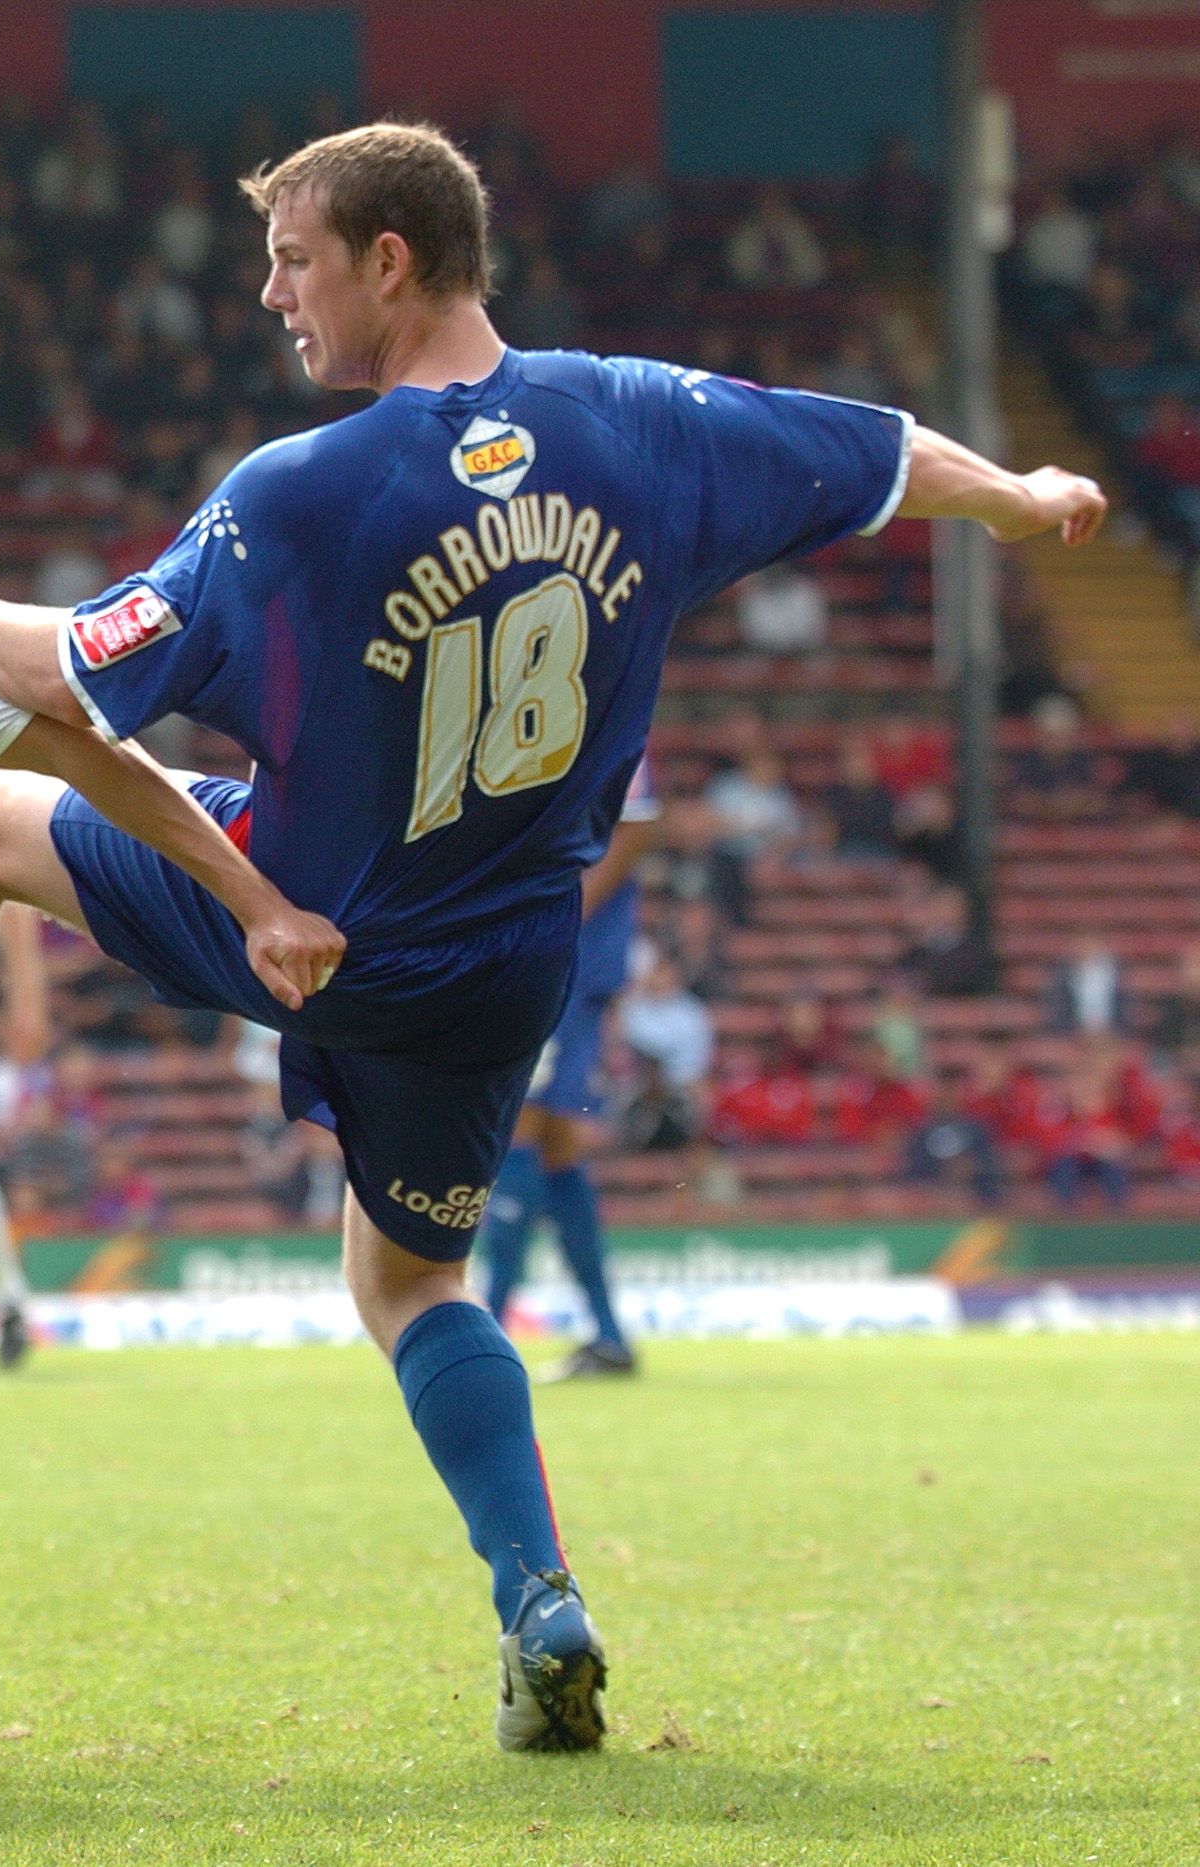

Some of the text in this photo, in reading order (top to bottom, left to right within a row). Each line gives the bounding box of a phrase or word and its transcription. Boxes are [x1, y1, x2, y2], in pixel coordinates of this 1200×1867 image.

[472, 441, 515, 472] GAC
[363, 493, 644, 682] BORROWDALE
[403, 572, 588, 844] 18
[387, 1179, 482, 1229] LOGIS
[446, 1184, 492, 1209] GA
